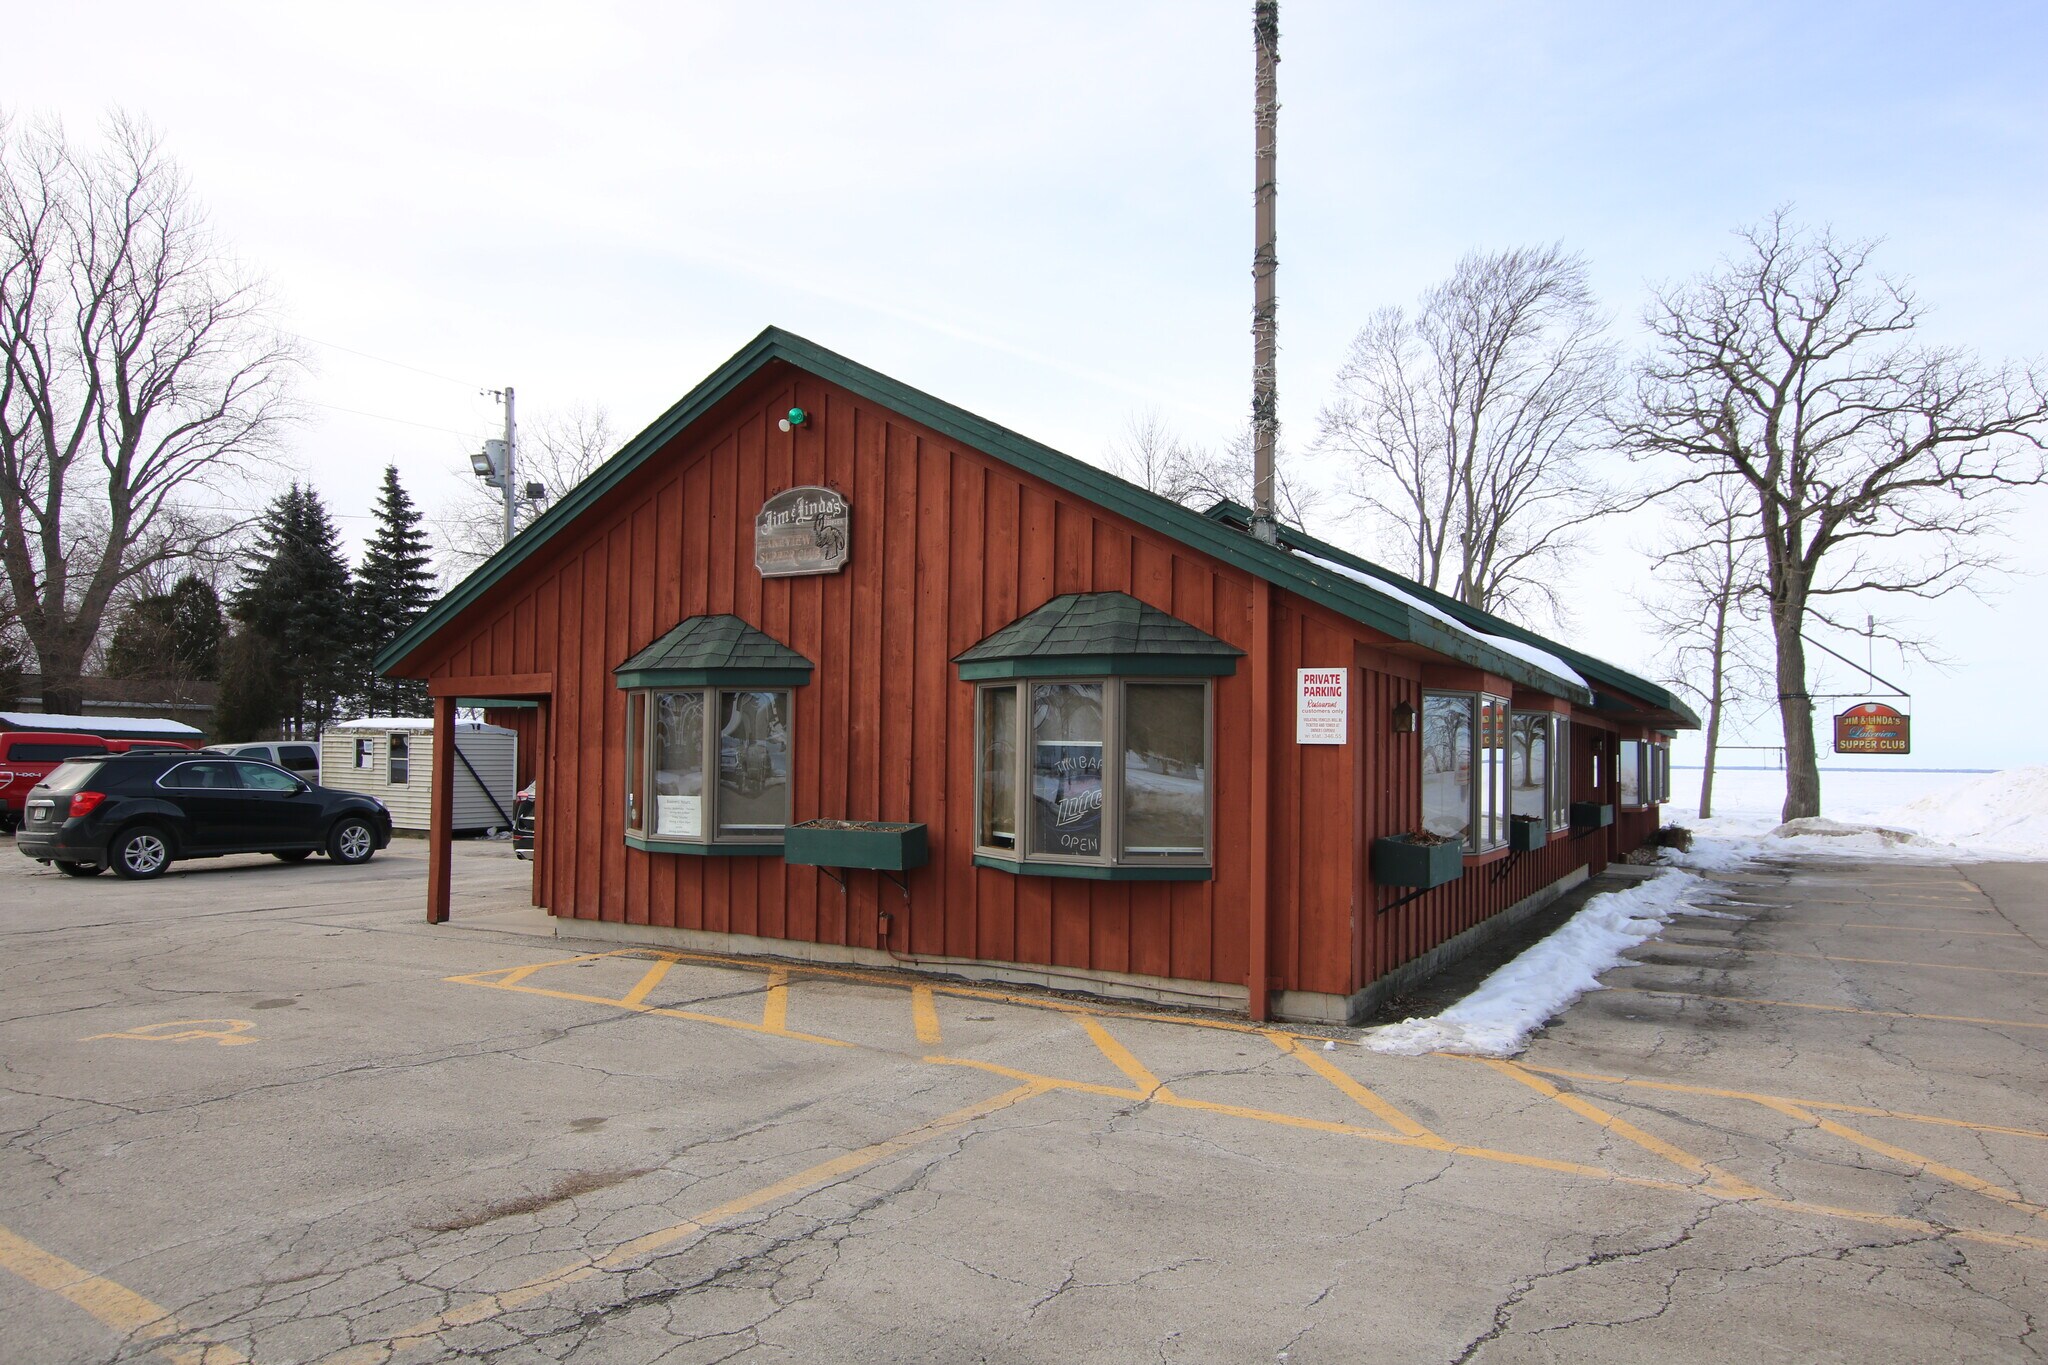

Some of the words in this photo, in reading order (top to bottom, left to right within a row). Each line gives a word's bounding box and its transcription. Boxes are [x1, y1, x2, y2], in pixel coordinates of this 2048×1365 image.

[761, 510, 789, 535] Jim
[796, 496, 842, 525] Linda's
[1303, 673, 1341, 685] PRIVATE
[1303, 686, 1342, 697] PARKING
[1843, 716, 1859, 725] JIM
[1860, 716, 1866, 725] &
[1847, 725, 1898, 739] Lakeview
[1840, 740, 1878, 749] SUPPER
[1880, 740, 1906, 749] CLUB
[1061, 834, 1098, 851] OPEN
